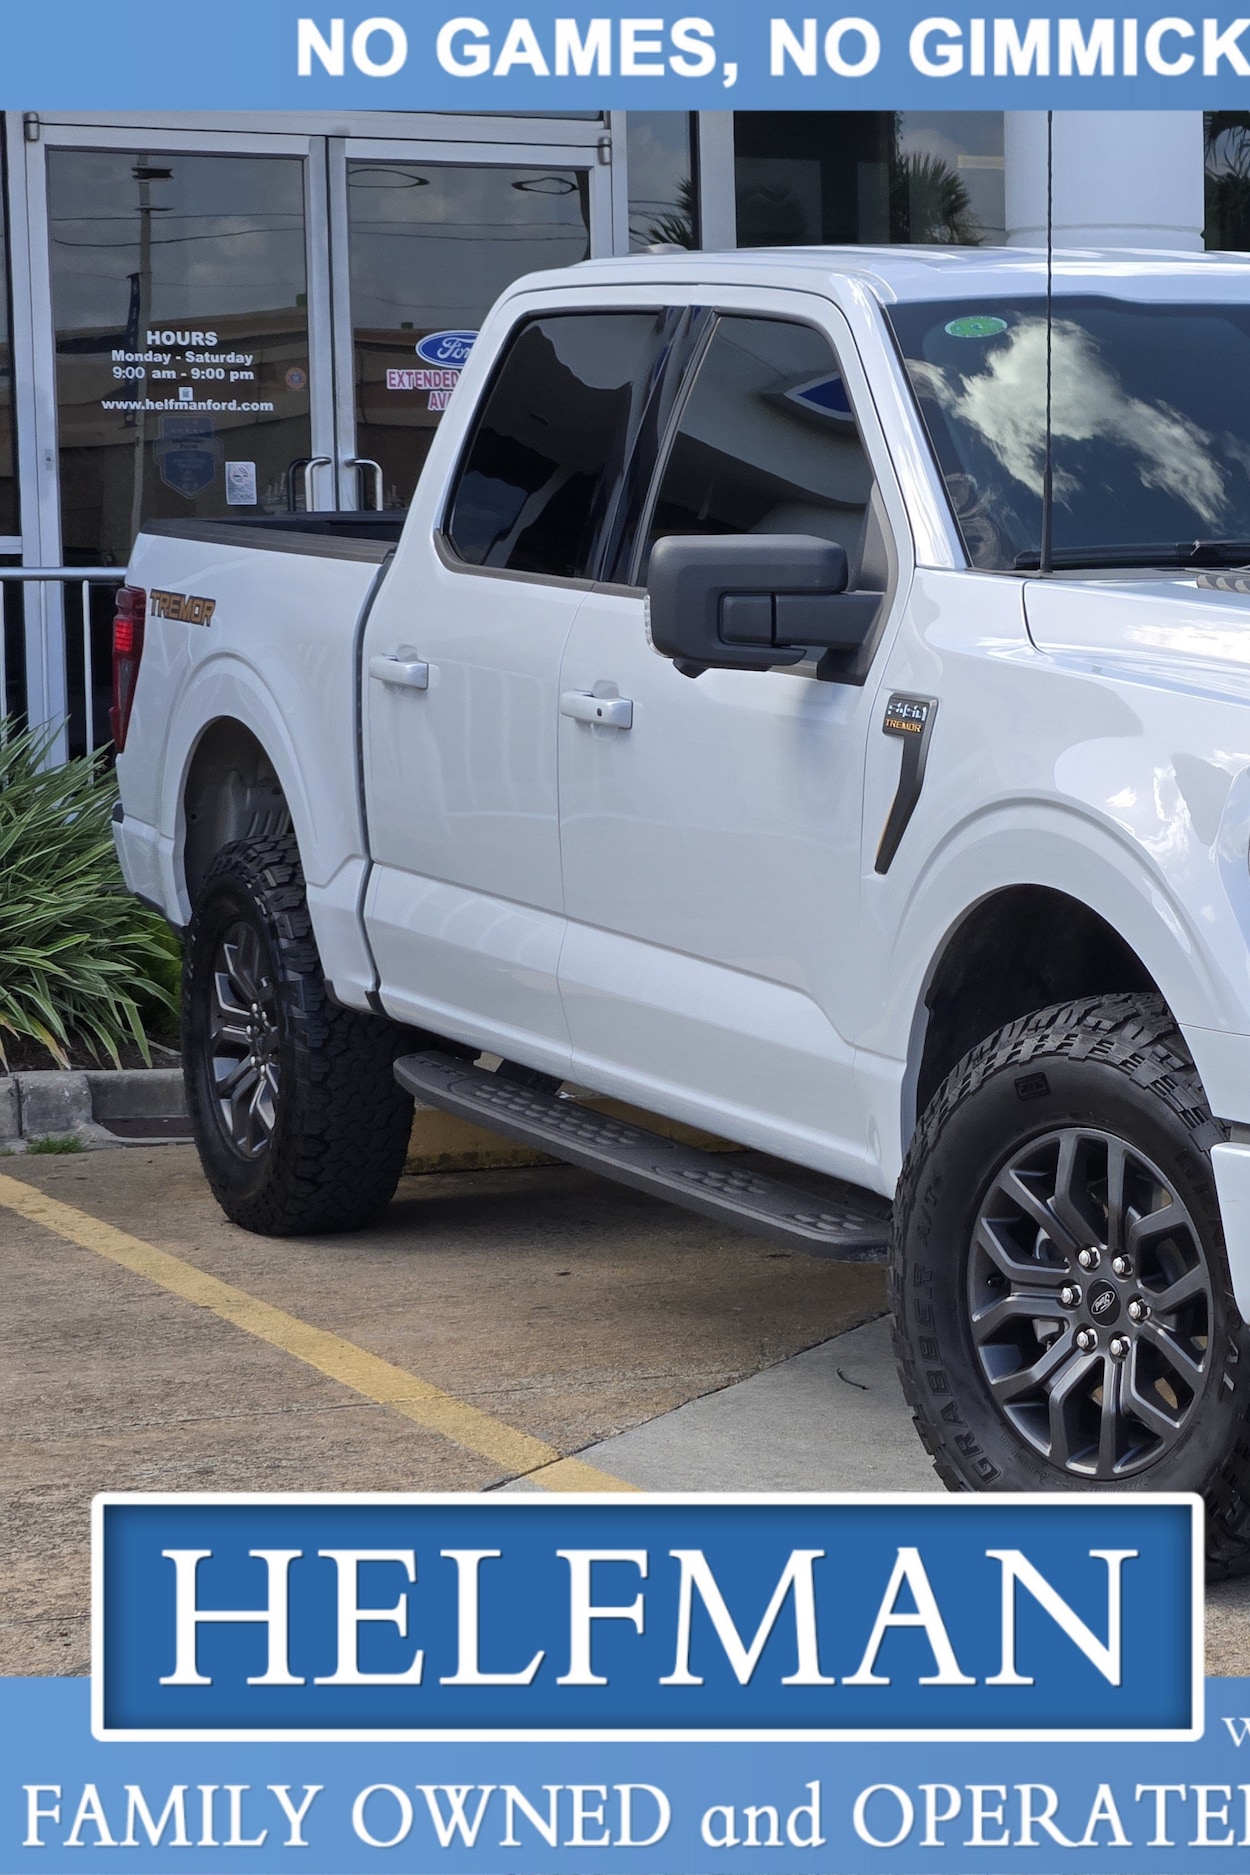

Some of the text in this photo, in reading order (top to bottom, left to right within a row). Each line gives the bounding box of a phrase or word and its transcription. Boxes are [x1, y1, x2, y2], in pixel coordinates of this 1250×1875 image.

[147, 331, 218, 346] HOURS
[111, 350, 171, 365] Monday
[185, 352, 253, 366] Saturday
[112, 366, 146, 379] 9:00
[151, 369, 177, 379] am
[191, 368, 225, 379] 9:00
[230, 370, 254, 382] pm
[388, 370, 460, 388] EXTENDED
[101, 399, 274, 411] www.helfmanford.com
[150, 588, 216, 627] TREMOR
[886, 718, 922, 733] TREMOR
[913, 1262, 1002, 1485] GRABBER
